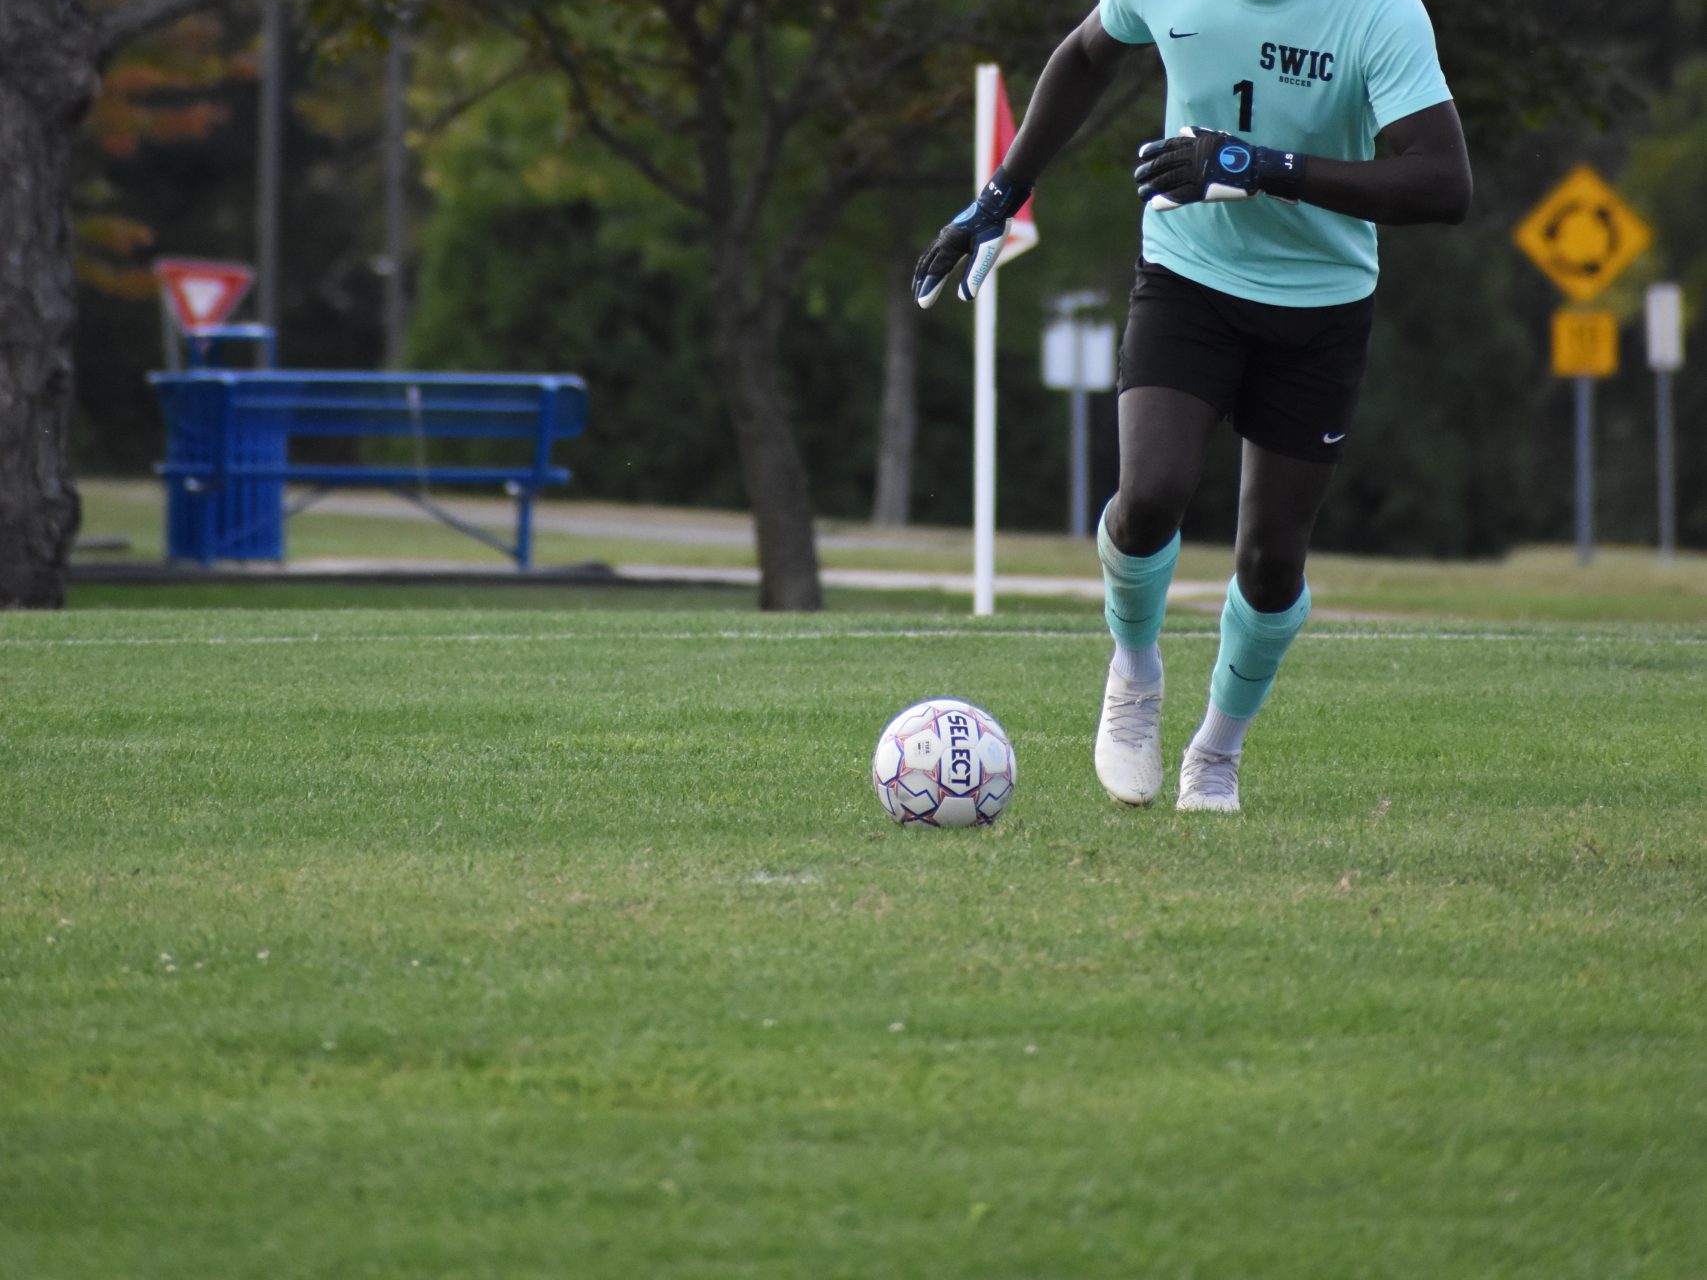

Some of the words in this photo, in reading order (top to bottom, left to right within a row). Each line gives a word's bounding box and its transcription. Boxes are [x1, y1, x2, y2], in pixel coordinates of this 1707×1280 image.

[1260, 42, 1334, 82] SWIC
[1279, 75, 1312, 88] SOCCER
[1233, 79, 1254, 132] 1
[972, 245, 995, 287] uhlsport
[947, 715, 971, 787] SELECT
